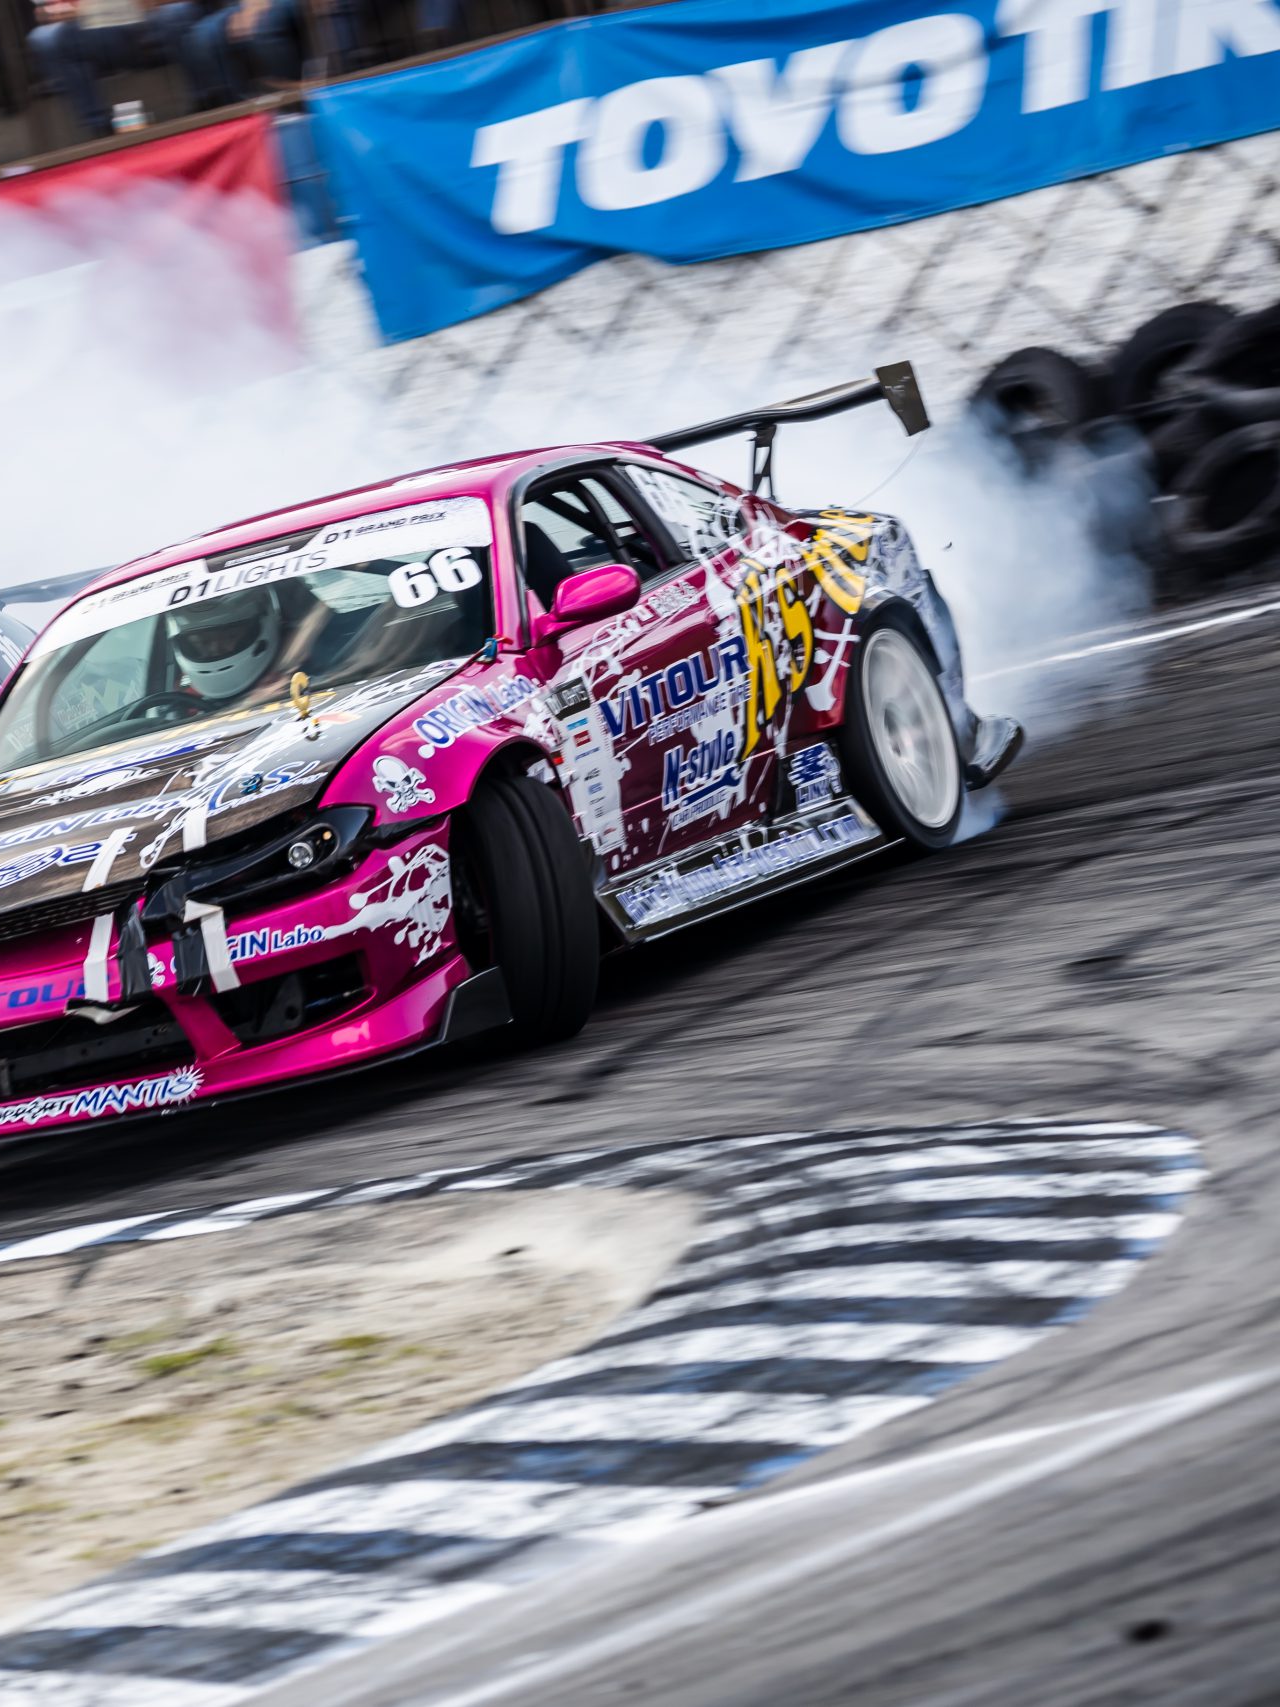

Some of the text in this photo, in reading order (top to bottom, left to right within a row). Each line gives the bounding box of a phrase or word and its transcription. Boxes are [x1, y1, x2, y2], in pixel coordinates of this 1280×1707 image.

[471, 10, 991, 236] TOYO
[388, 546, 483, 608] 66
[413, 686, 498, 748] ORIGIN
[598, 634, 752, 741] VITOUR
[662, 728, 736, 812] N-style
[69, 1073, 198, 1117] MANTIS
